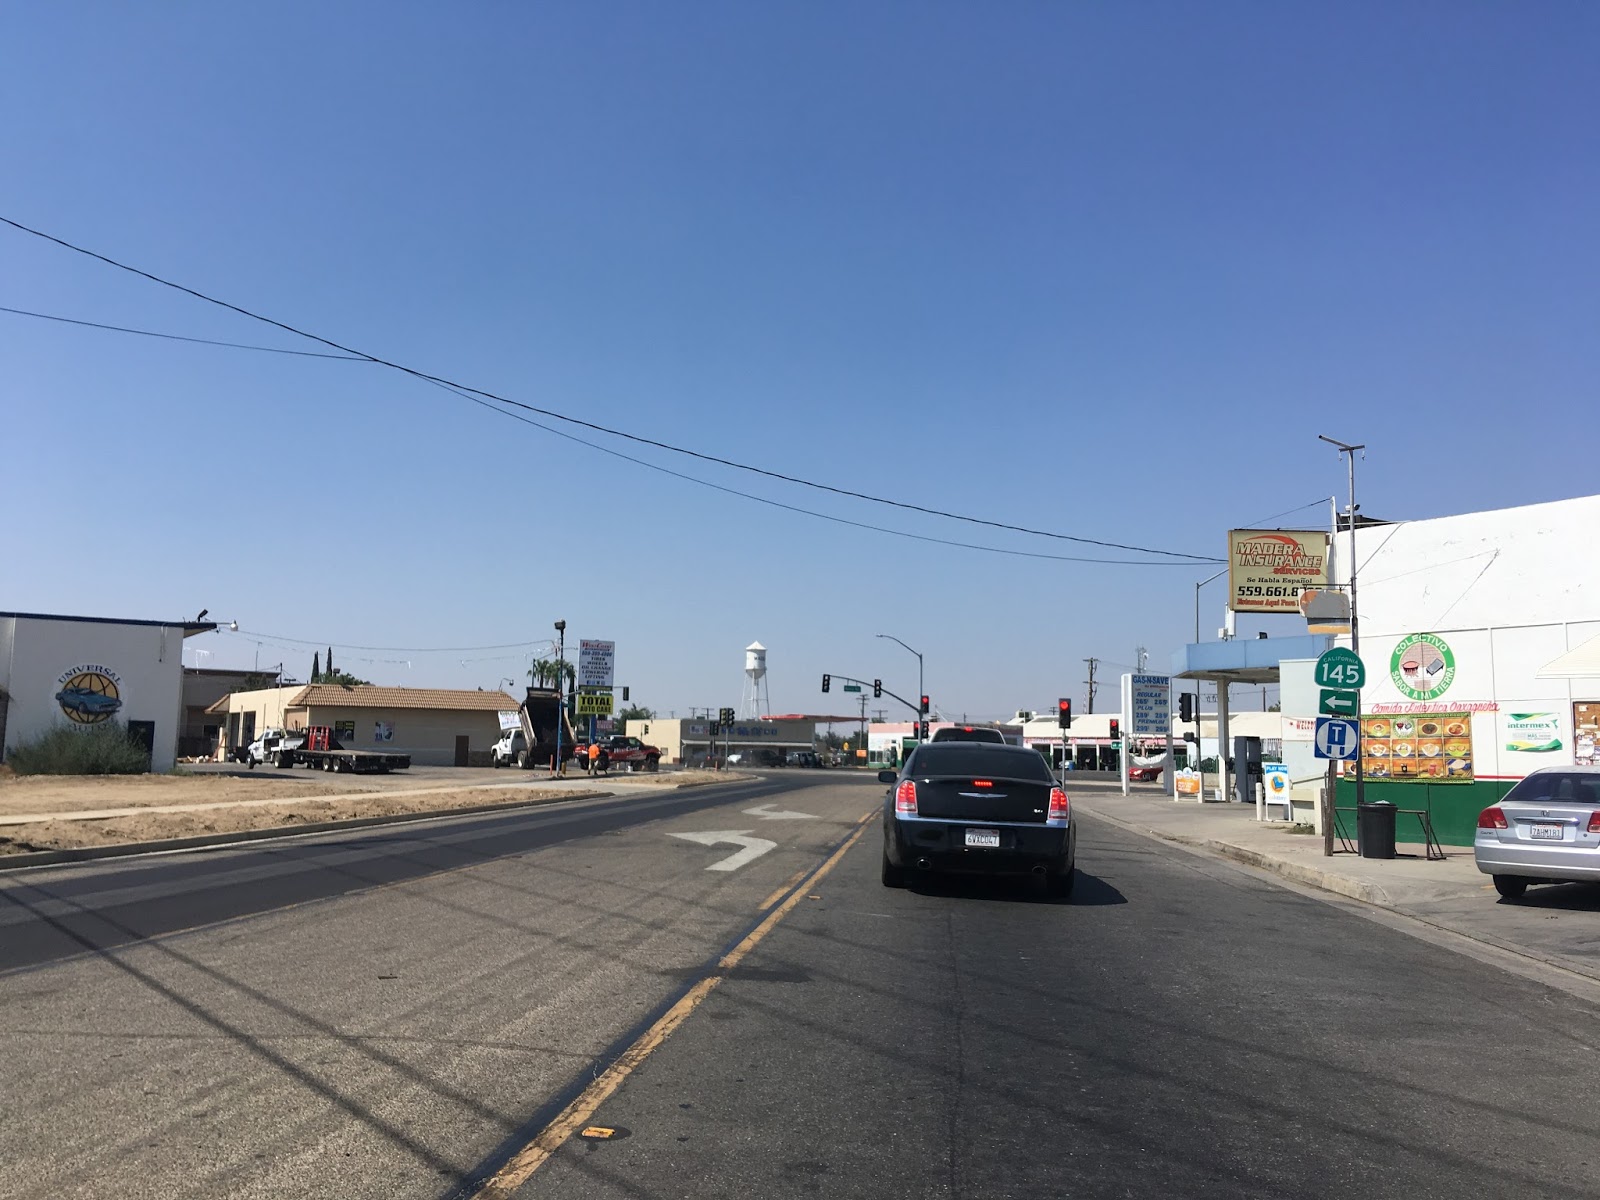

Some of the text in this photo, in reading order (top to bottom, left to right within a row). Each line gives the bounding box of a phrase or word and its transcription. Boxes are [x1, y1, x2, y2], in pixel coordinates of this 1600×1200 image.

[1236, 542, 1307, 556] MADERA
[1239, 554, 1322, 568] INSURANCE
[1273, 567, 1321, 576] SERVICES
[1237, 586, 1322, 597] 559.661.8
[1395, 634, 1448, 655] COLECTIVO
[1323, 656, 1359, 665] CALIFORNIA
[58, 664, 121, 685] UNIVERSAL
[1322, 663, 1360, 684] 145
[1392, 671, 1411, 696] SABOR
[1420, 692, 1433, 700] MI
[1433, 666, 1455, 695] TIERRA
[581, 696, 611, 706] TOTAL
[580, 705, 596, 713] AUTO
[1296, 720, 1316, 730] WELCO
[1331, 726, 1342, 742] T
